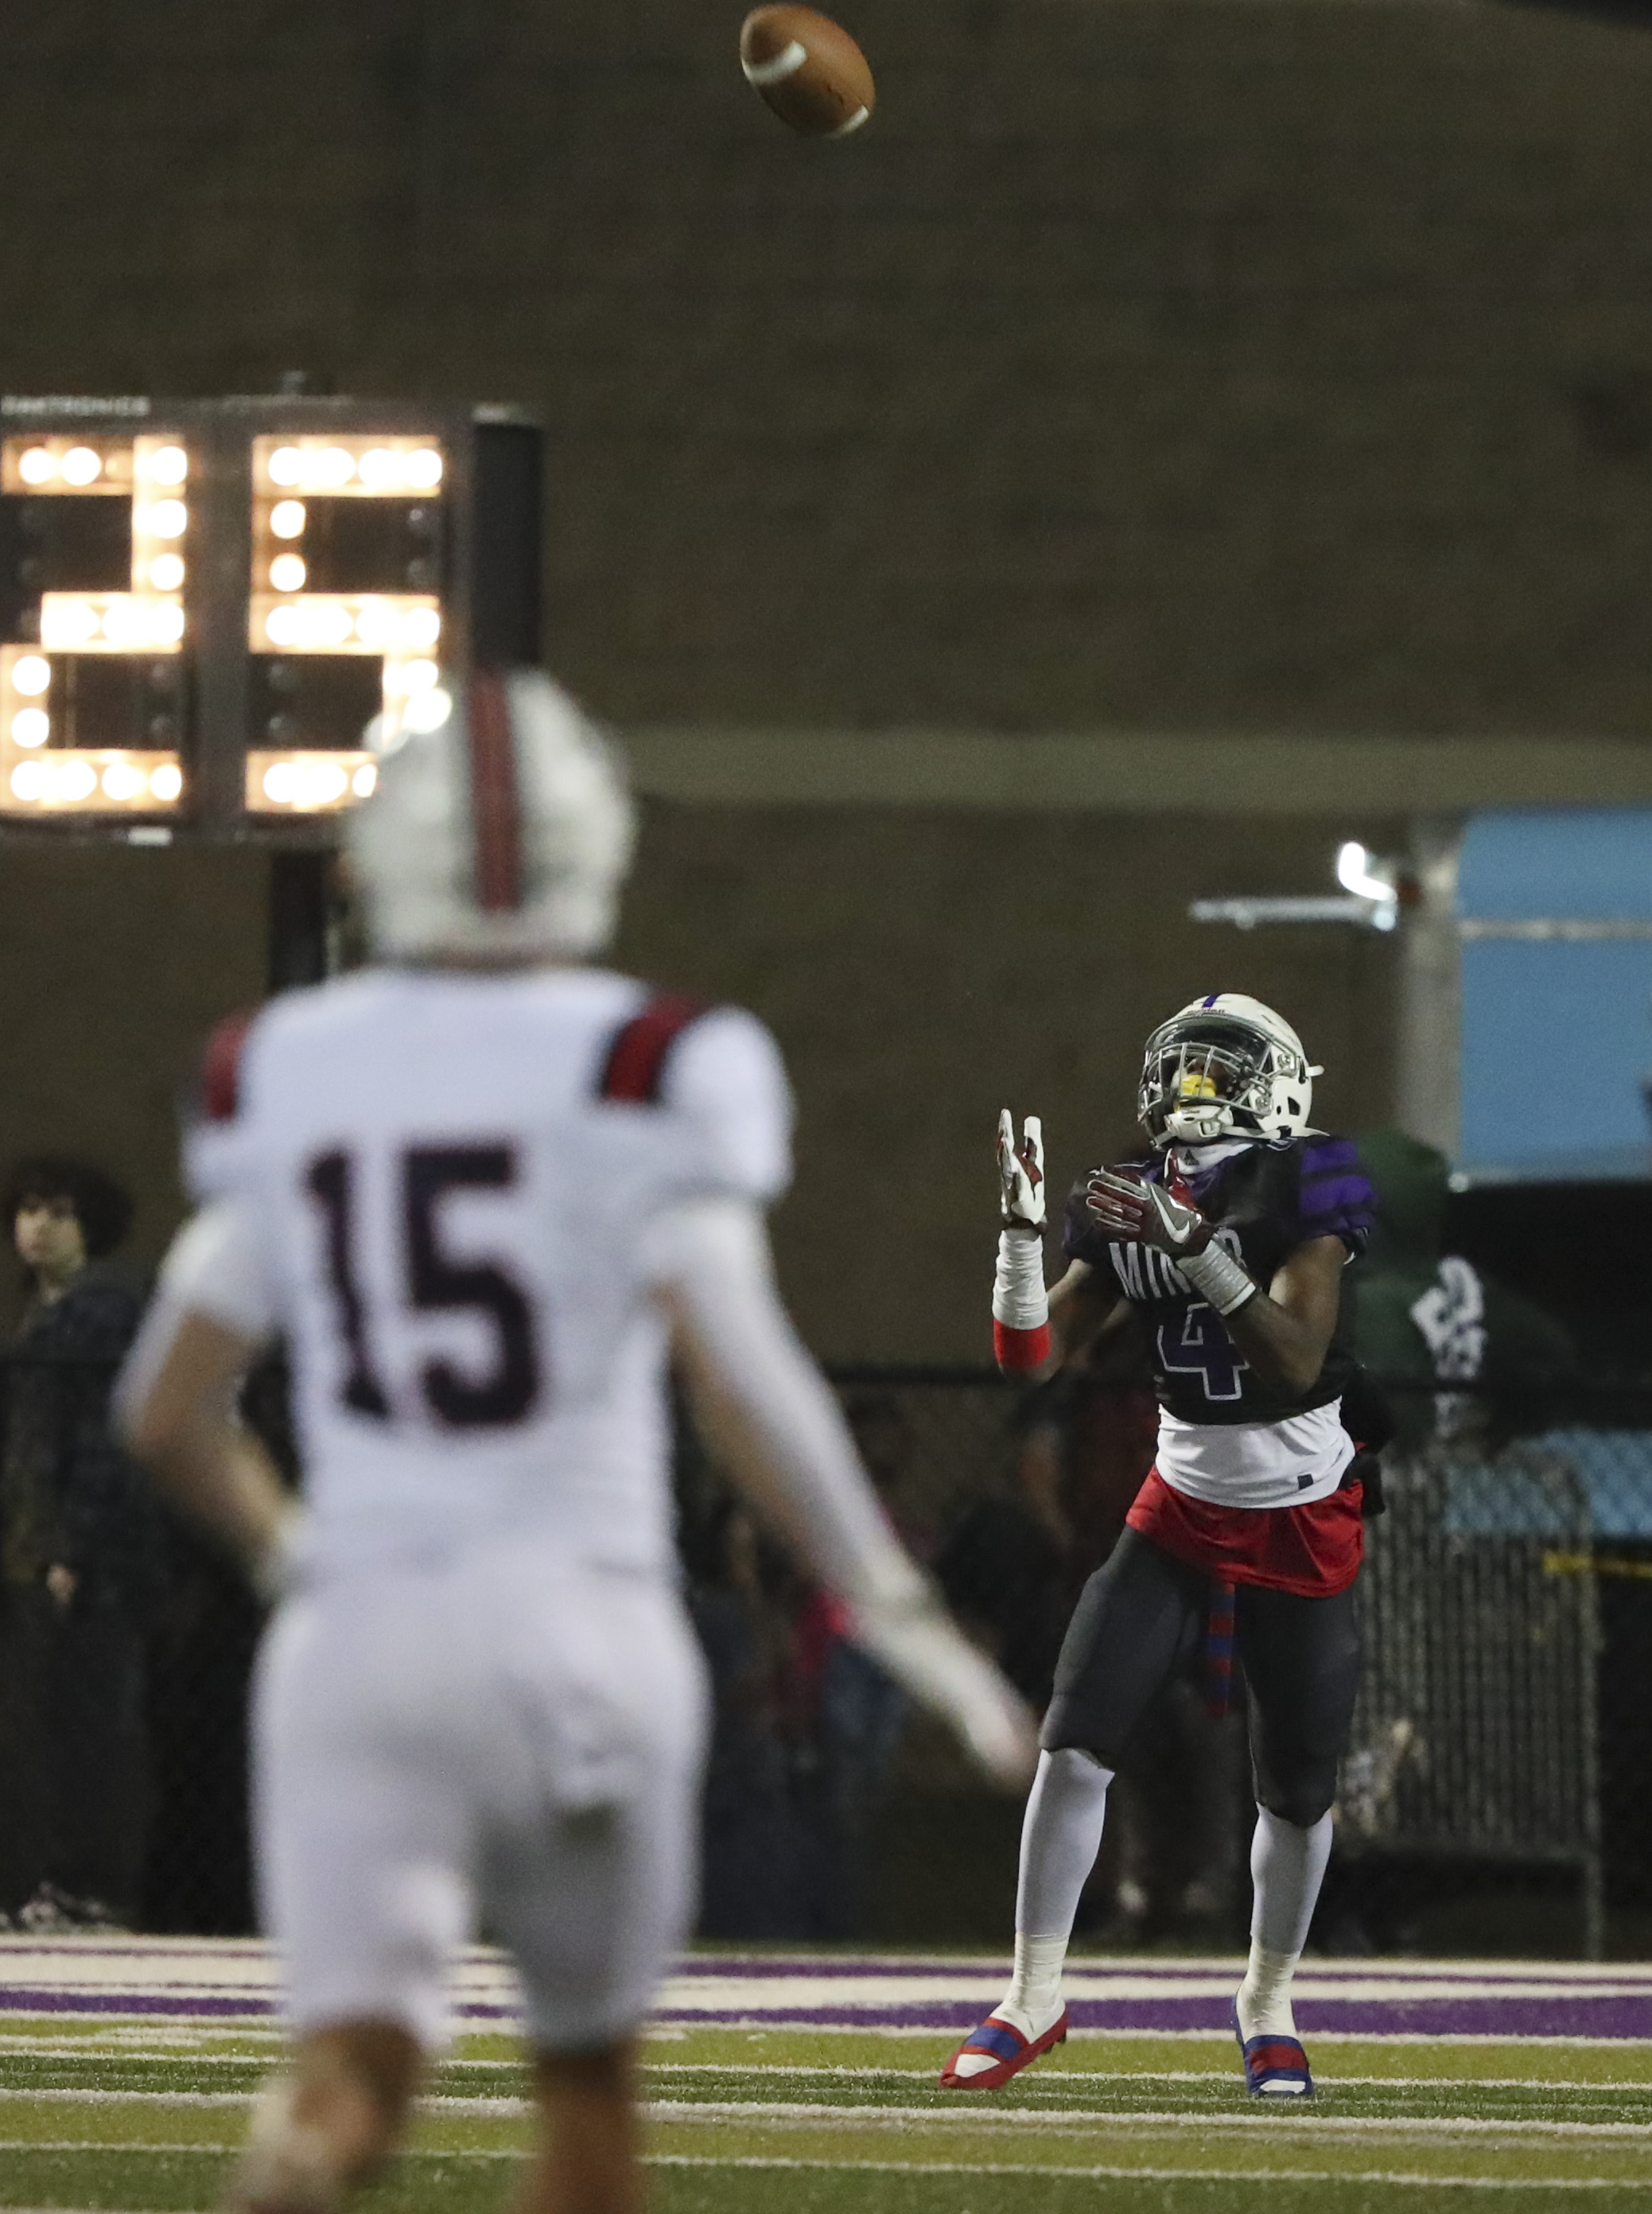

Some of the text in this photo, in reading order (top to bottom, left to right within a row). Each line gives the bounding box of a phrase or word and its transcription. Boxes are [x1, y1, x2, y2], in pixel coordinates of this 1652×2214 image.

[0, 434, 445, 813] 25
[301, 1144, 541, 1427] 15
[1108, 1226, 1248, 1300] MINR
[1156, 1302, 1251, 1401] 4
